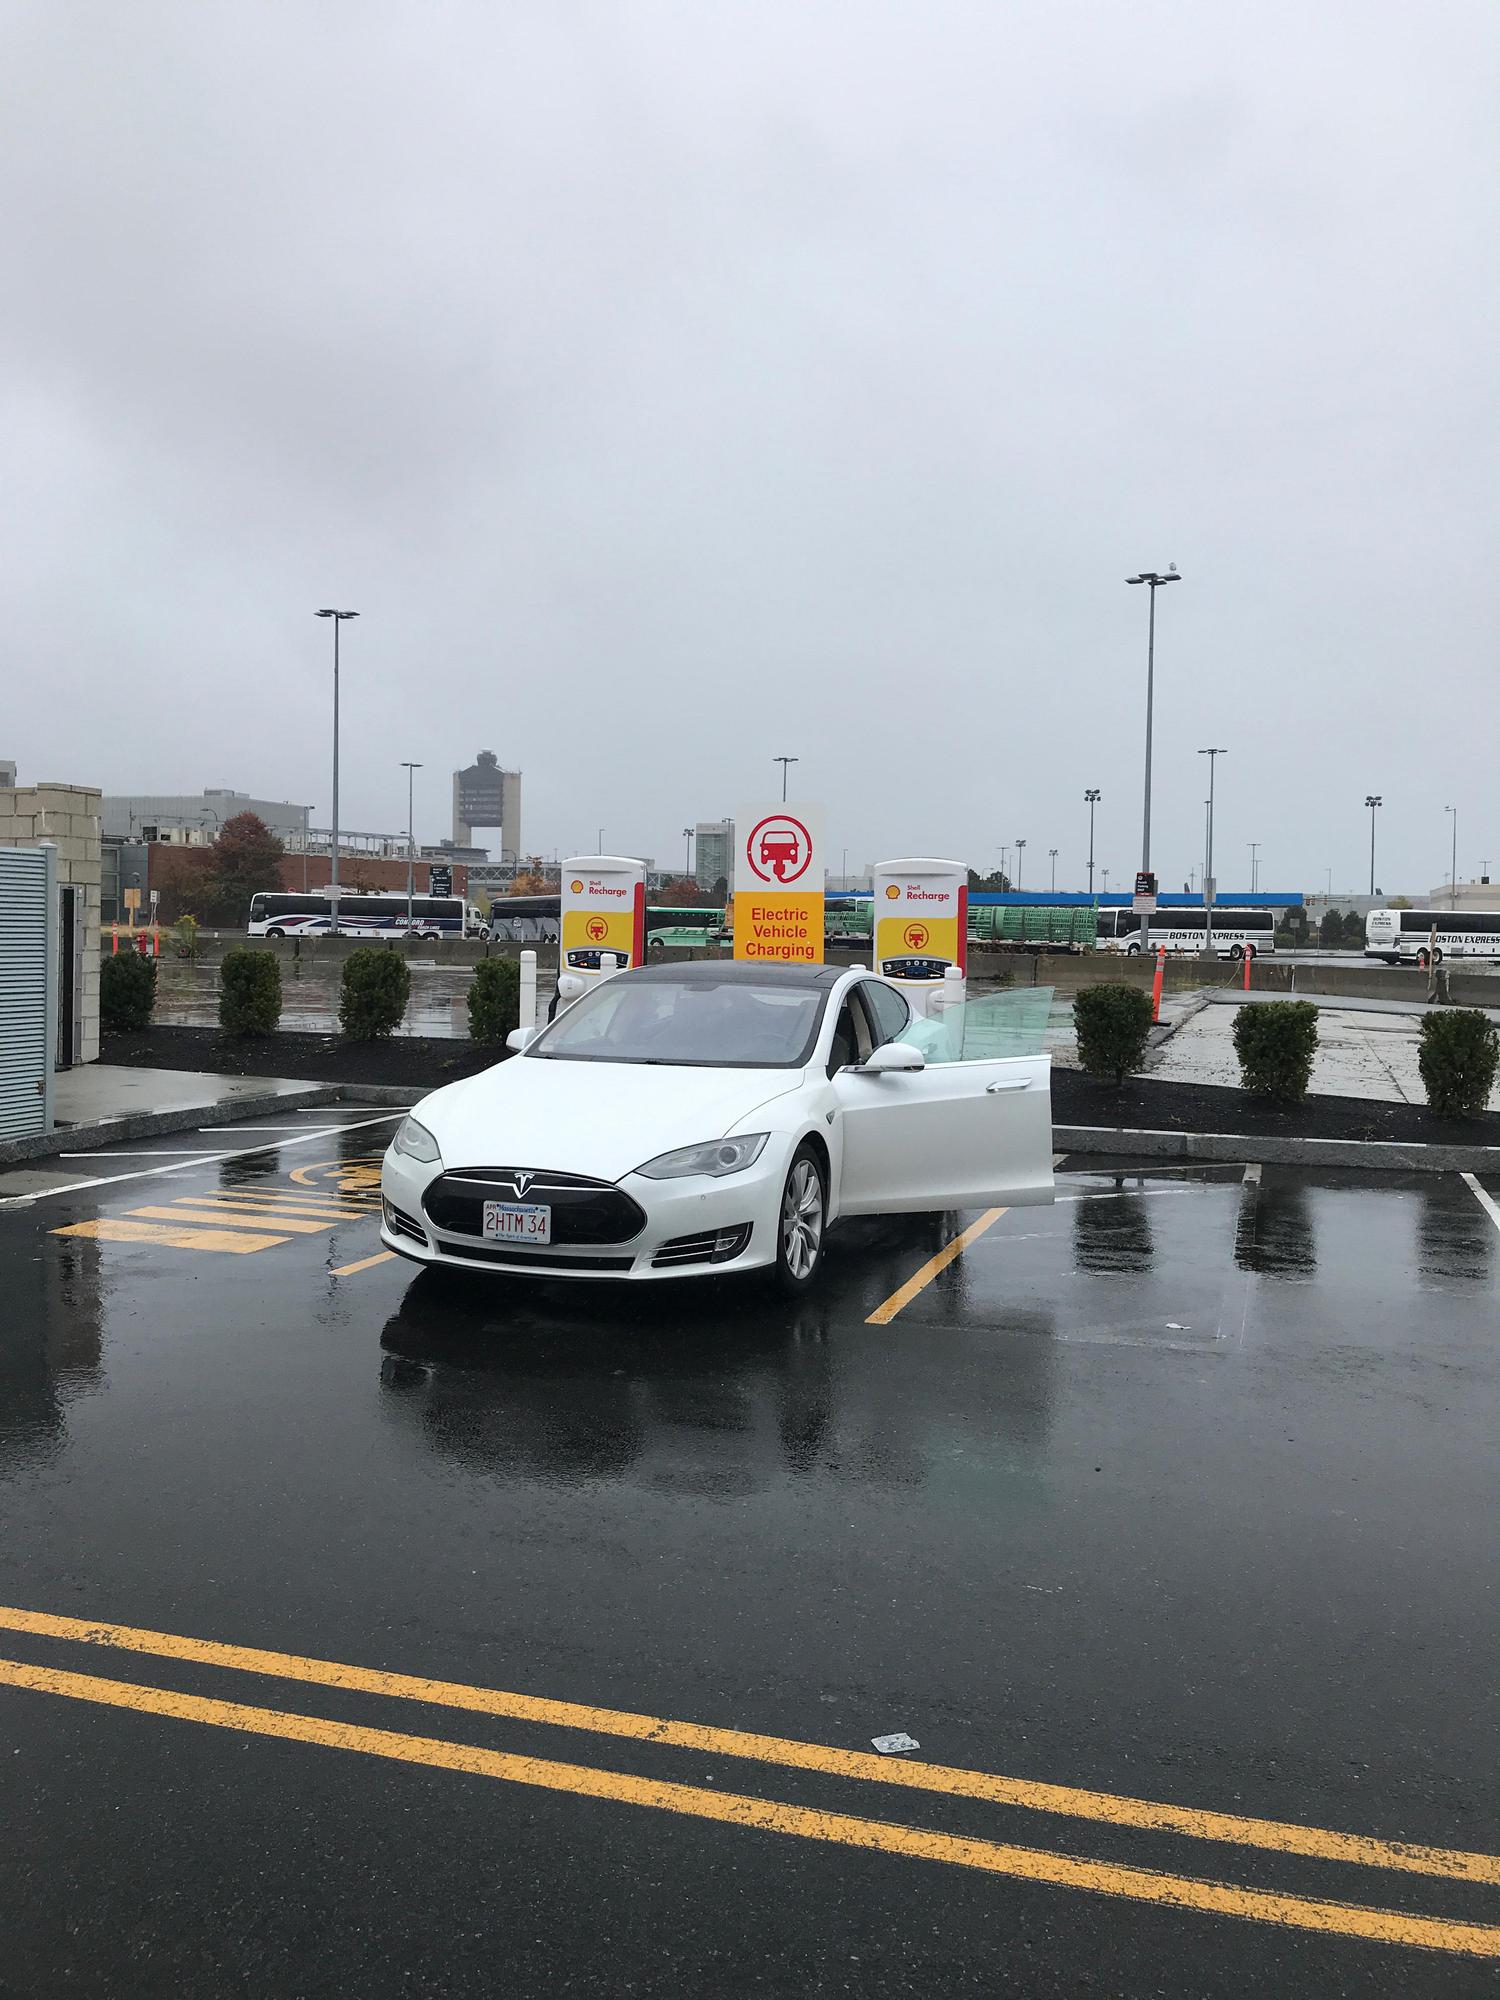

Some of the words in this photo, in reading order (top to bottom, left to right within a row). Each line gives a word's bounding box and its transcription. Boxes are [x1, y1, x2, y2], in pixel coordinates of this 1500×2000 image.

[589, 887, 627, 897] Recharge
[906, 891, 950, 902] Recharge
[752, 908, 809, 921] Electric
[753, 925, 807, 938] Vehicle
[1169, 931, 1206, 940] BOSTON
[1207, 932, 1245, 940] XPRESS
[746, 942, 815, 959] Charging
[486, 1211, 524, 1233] 2HTM
[528, 1213, 546, 1235] 34
